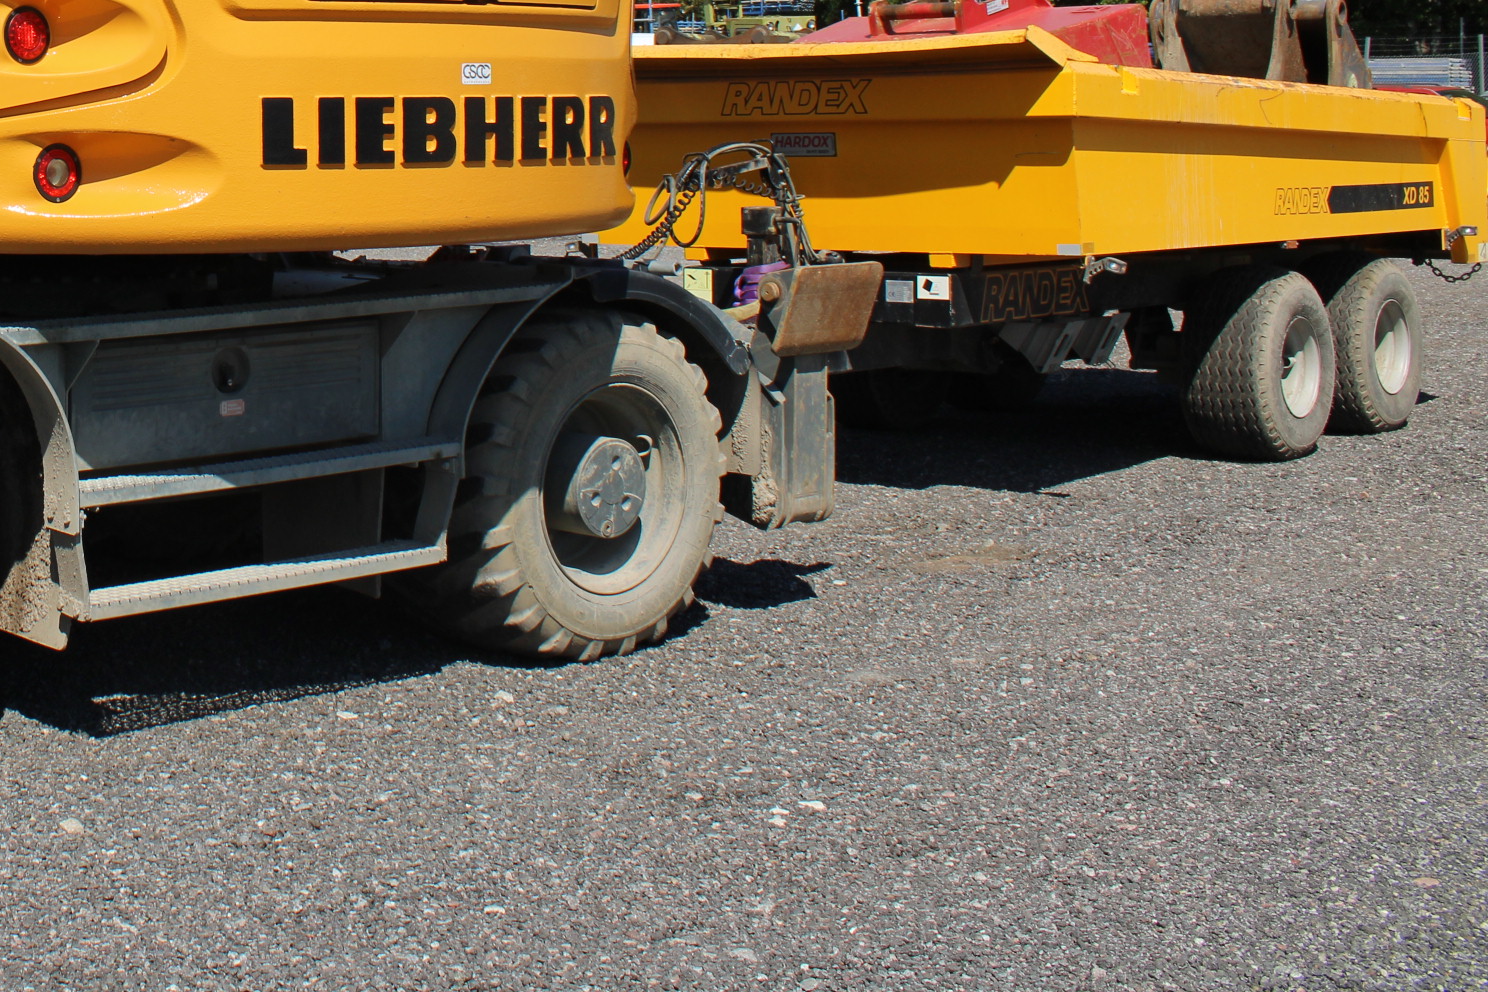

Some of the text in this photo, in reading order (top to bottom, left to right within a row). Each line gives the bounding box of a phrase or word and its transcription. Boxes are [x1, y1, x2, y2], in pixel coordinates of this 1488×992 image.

[721, 79, 872, 116] RANDEX
[262, 96, 616, 165] LIEBHERR
[774, 135, 830, 148] HARDOX
[1274, 186, 1430, 215] RANDEX XD 85
[980, 266, 1091, 324] RANDEX
